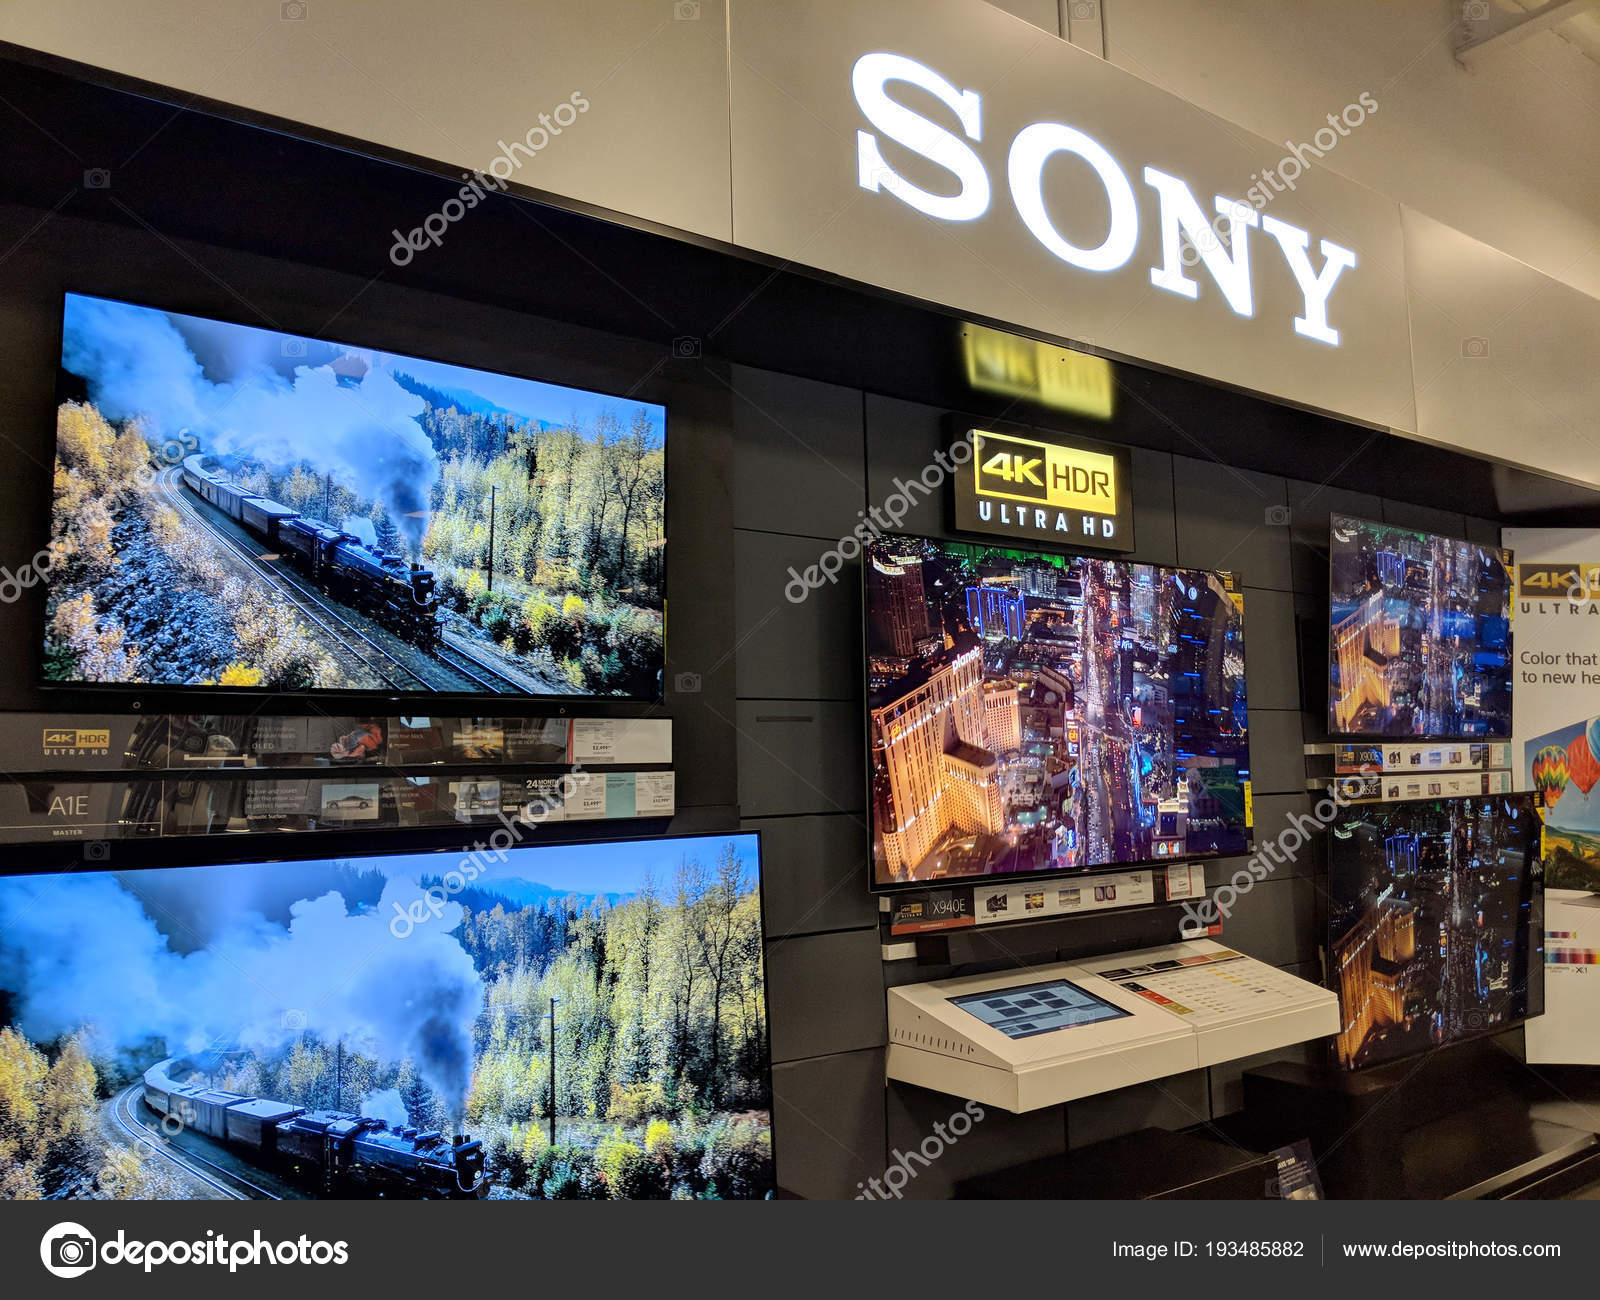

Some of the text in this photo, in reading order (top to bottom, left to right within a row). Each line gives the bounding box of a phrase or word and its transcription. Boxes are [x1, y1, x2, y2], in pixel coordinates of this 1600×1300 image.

[852, 52, 1356, 346] SONY
[982, 452, 1110, 498] 4K HDR
[978, 500, 1114, 538] ULTRA HD
[1523, 571, 1577, 589] 4K
[1521, 602, 1599, 615] ULTRA
[1520, 651, 1598, 666] Color that
[1521, 670, 1537, 684] to
[1542, 672, 1576, 684] new
[47, 734, 107, 743] 4K HDR
[44, 748, 108, 756] ULTRA HD
[47, 795, 89, 816] A1E
[932, 898, 966, 915] X940E
